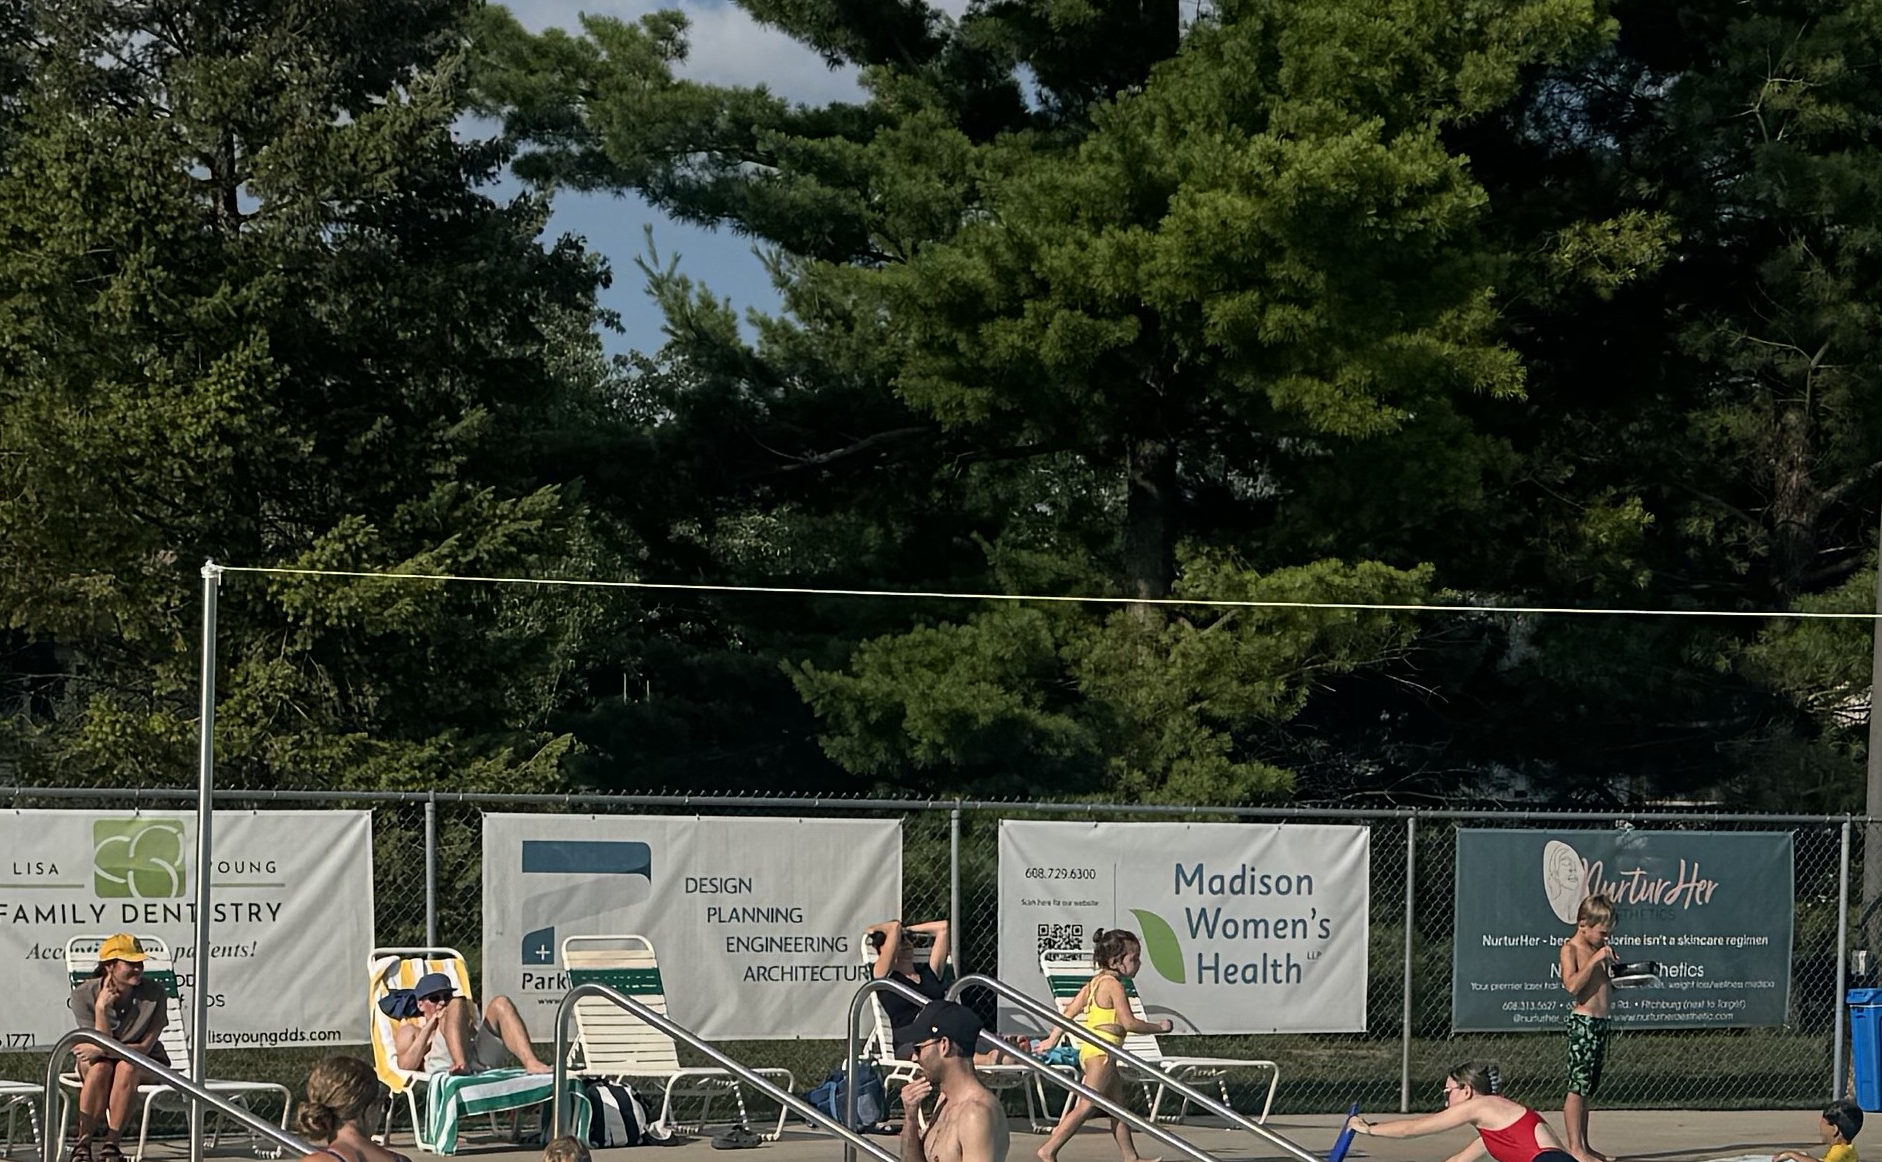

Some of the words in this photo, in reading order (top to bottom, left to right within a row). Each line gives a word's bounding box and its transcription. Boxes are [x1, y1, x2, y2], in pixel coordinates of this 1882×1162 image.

[13, 861, 60, 876] LISA
[210, 860, 277, 874] OUNG
[685, 877, 753, 894] DESIGN
[1174, 863, 1314, 897] Madison
[122, 902, 283, 924] DENTSTRY
[707, 907, 803, 924] PLANNING
[1186, 907, 1331, 940] Women's
[726, 936, 848, 953] ENGINEERING
[1482, 934, 1540, 946] NurturHer
[1677, 934, 1724, 946] skincare
[1726, 934, 1769, 948] regimen
[174, 941, 257, 962] paents!
[743, 965, 868, 982] ARCHITECTUR
[1197, 952, 1302, 985] Health
